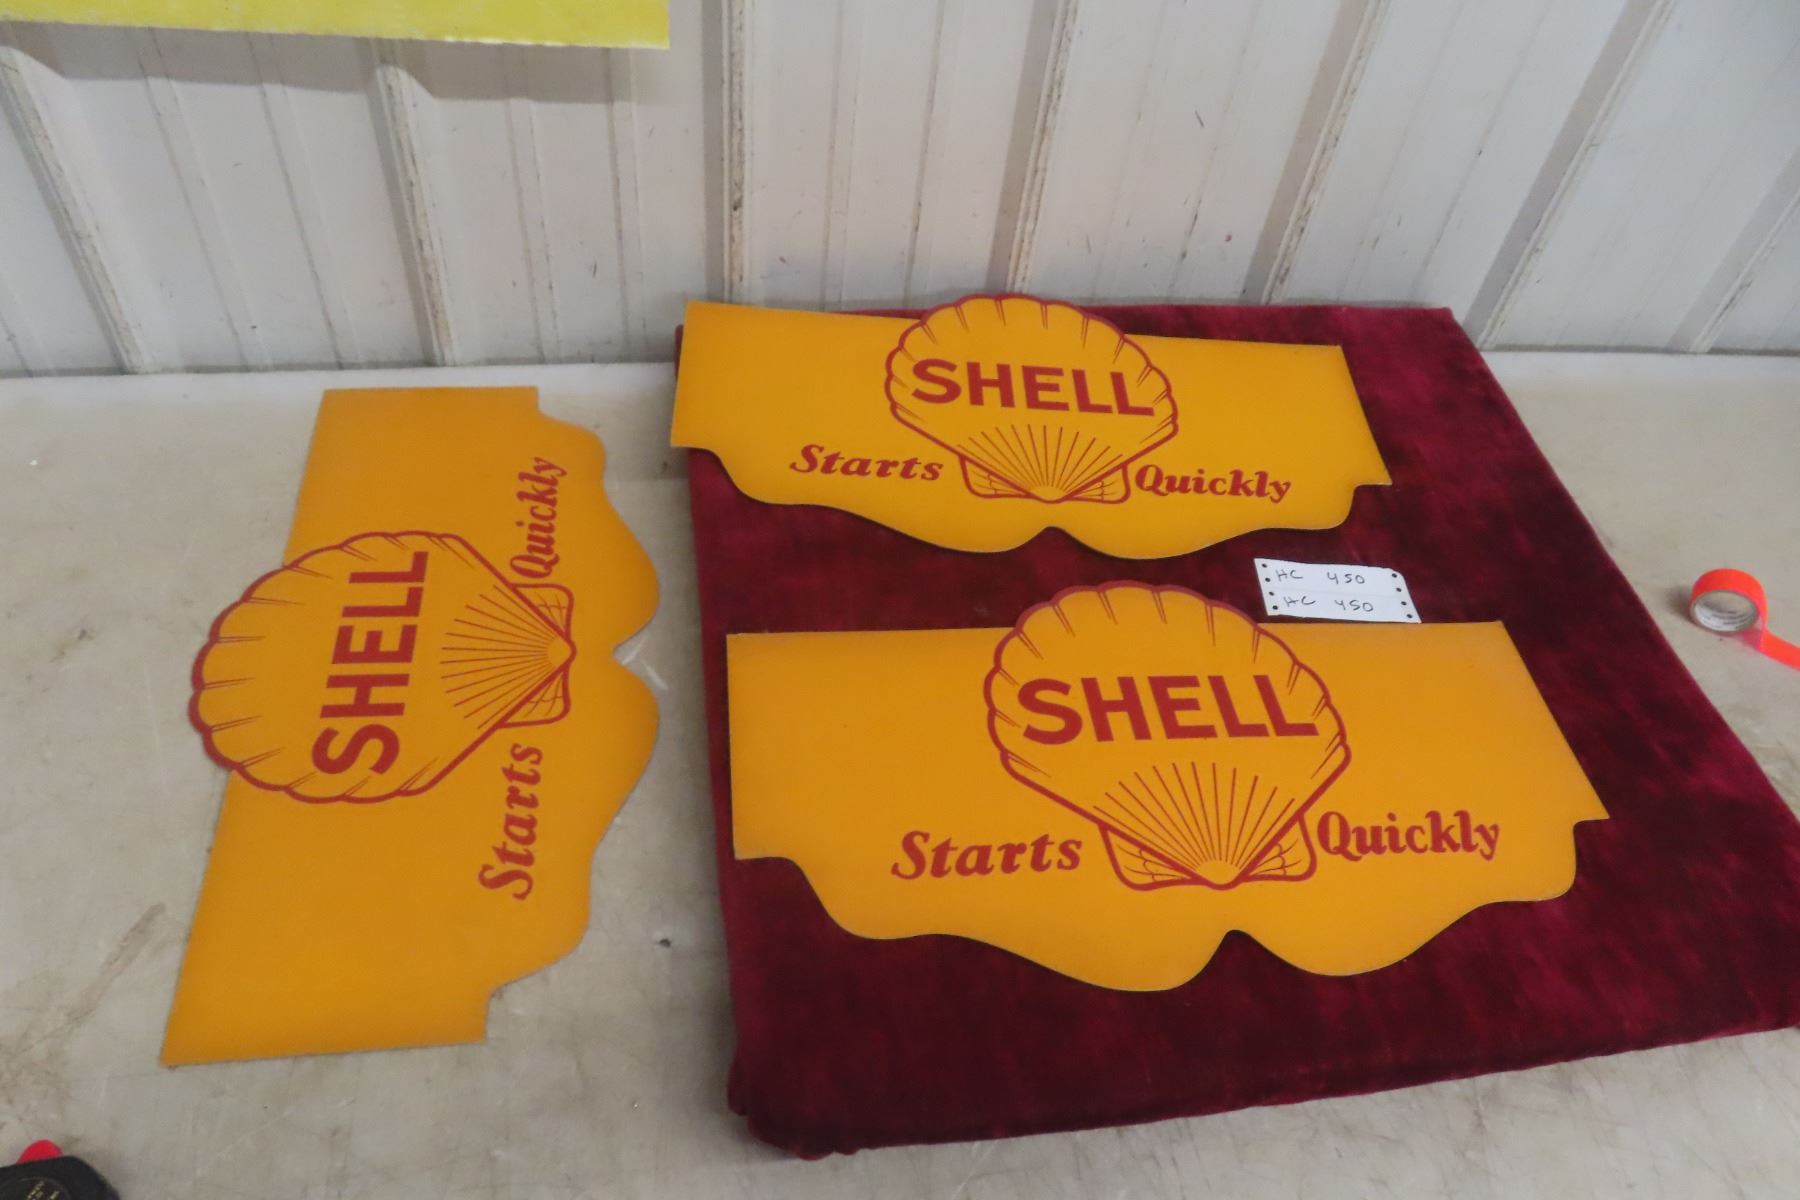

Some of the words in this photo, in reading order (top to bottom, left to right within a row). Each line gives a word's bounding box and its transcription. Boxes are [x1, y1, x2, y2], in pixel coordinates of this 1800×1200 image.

[911, 358, 1155, 416] SHELL
[789, 444, 944, 481] Starts
[1135, 464, 1291, 504] Quickly
[509, 456, 568, 580] Quickly
[1275, 569, 1304, 582] HC
[1326, 571, 1366, 585] 450
[1283, 595, 1316, 608] HC
[1334, 598, 1374, 612] 450
[311, 550, 429, 775] SHELL
[1017, 674, 1320, 746] SHELL
[478, 743, 543, 901] Starts
[890, 830, 1083, 880] Starts
[1317, 809, 1500, 861] Quickly
